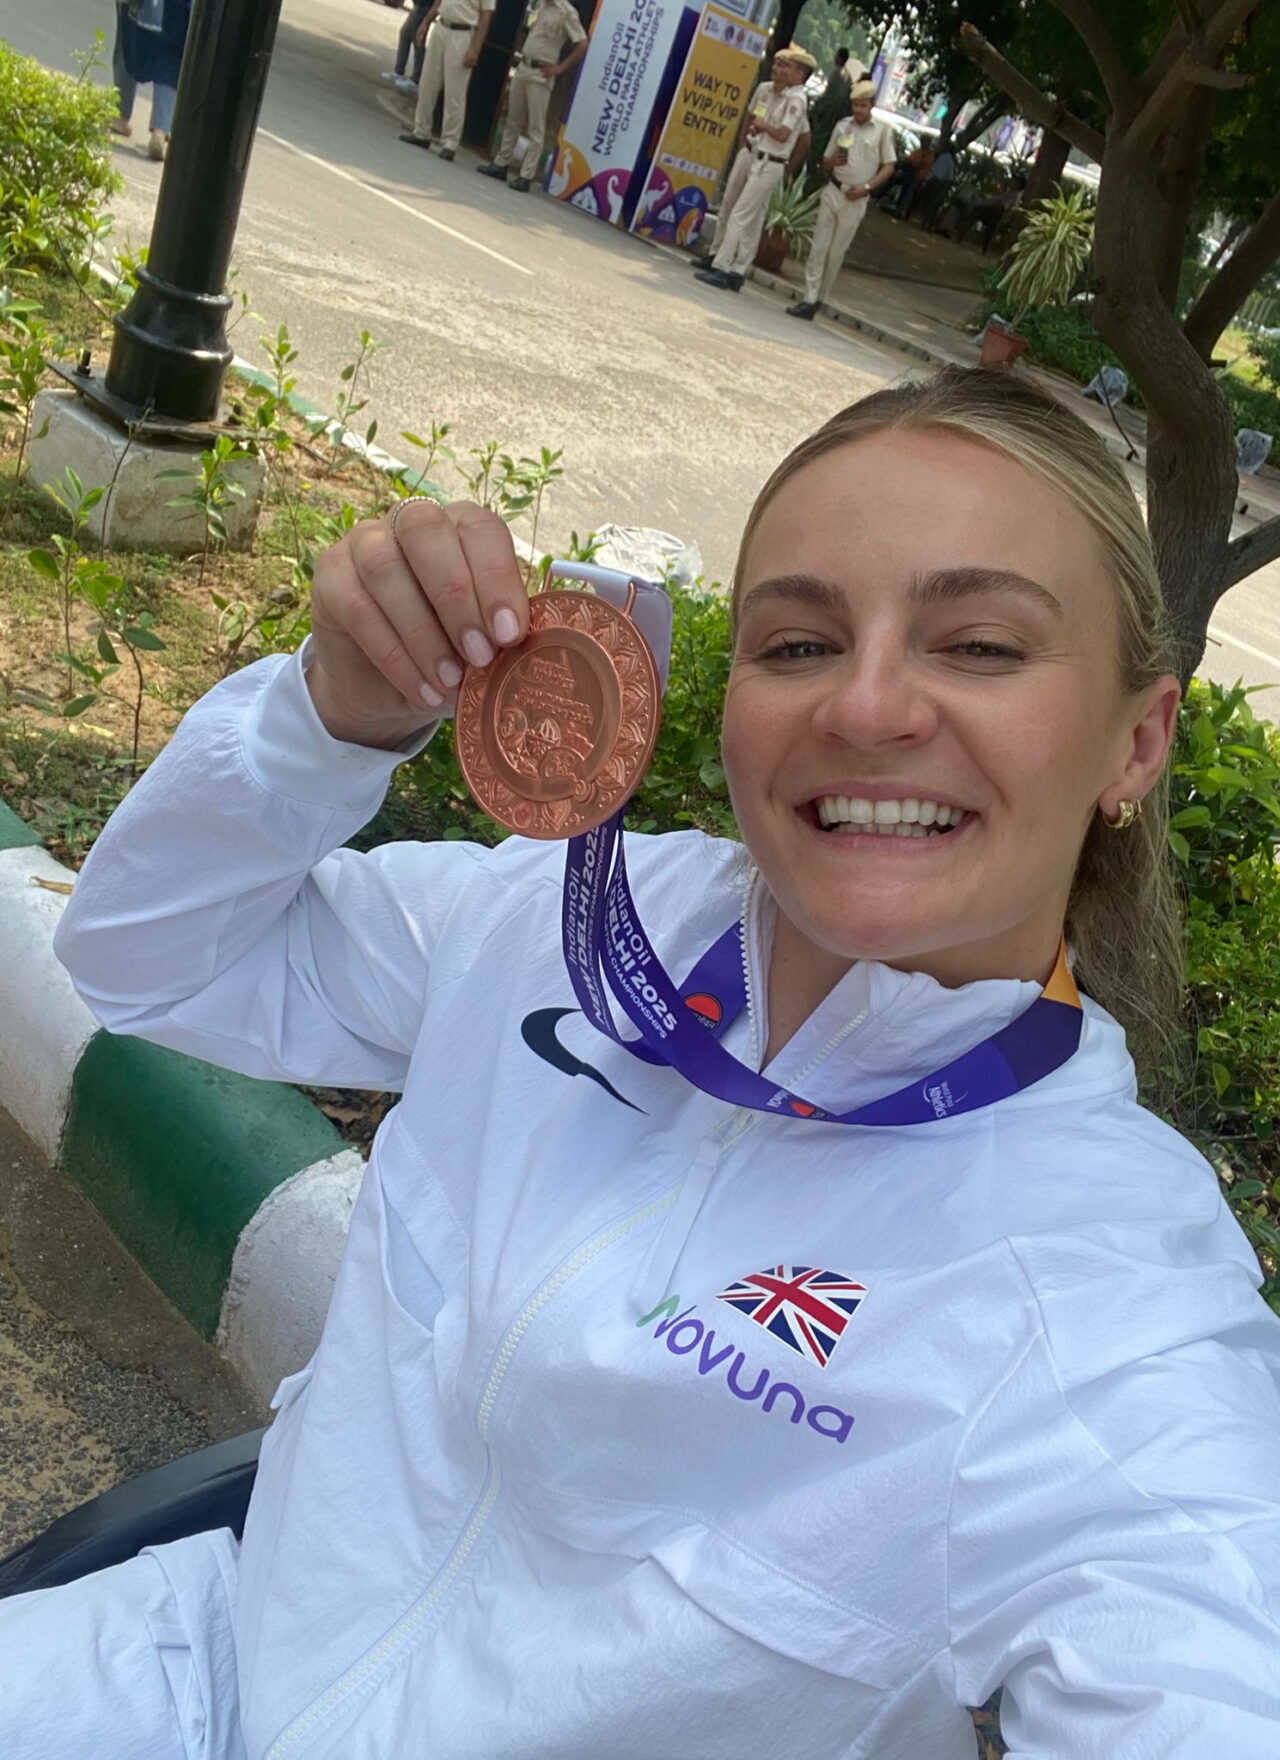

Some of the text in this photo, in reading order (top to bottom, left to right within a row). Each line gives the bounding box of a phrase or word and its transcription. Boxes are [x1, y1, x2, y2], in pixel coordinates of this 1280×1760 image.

[592, 98, 614, 154] NEW
[608, 27, 637, 96] DELHI
[599, 22, 625, 90] IndianOil
[620, 7, 664, 132] CHAMPIONSHIPS
[694, 70, 740, 101] WAY TO
[603, 104, 625, 156] WORLD
[620, 61, 638, 101] PARA
[682, 112, 728, 138] ENTRY
[683, 88, 739, 122] VVIP/VIP
[566, 867, 580, 965] IndianOil
[577, 884, 590, 966] DELHI
[580, 967, 604, 1025] NEW
[609, 884, 678, 1031] DELHI 2025
[611, 957, 667, 1039] CHAMPIONSHIPS
[929, 1086, 947, 1118] Athletics
[636, 1294, 855, 1444] Novuna
